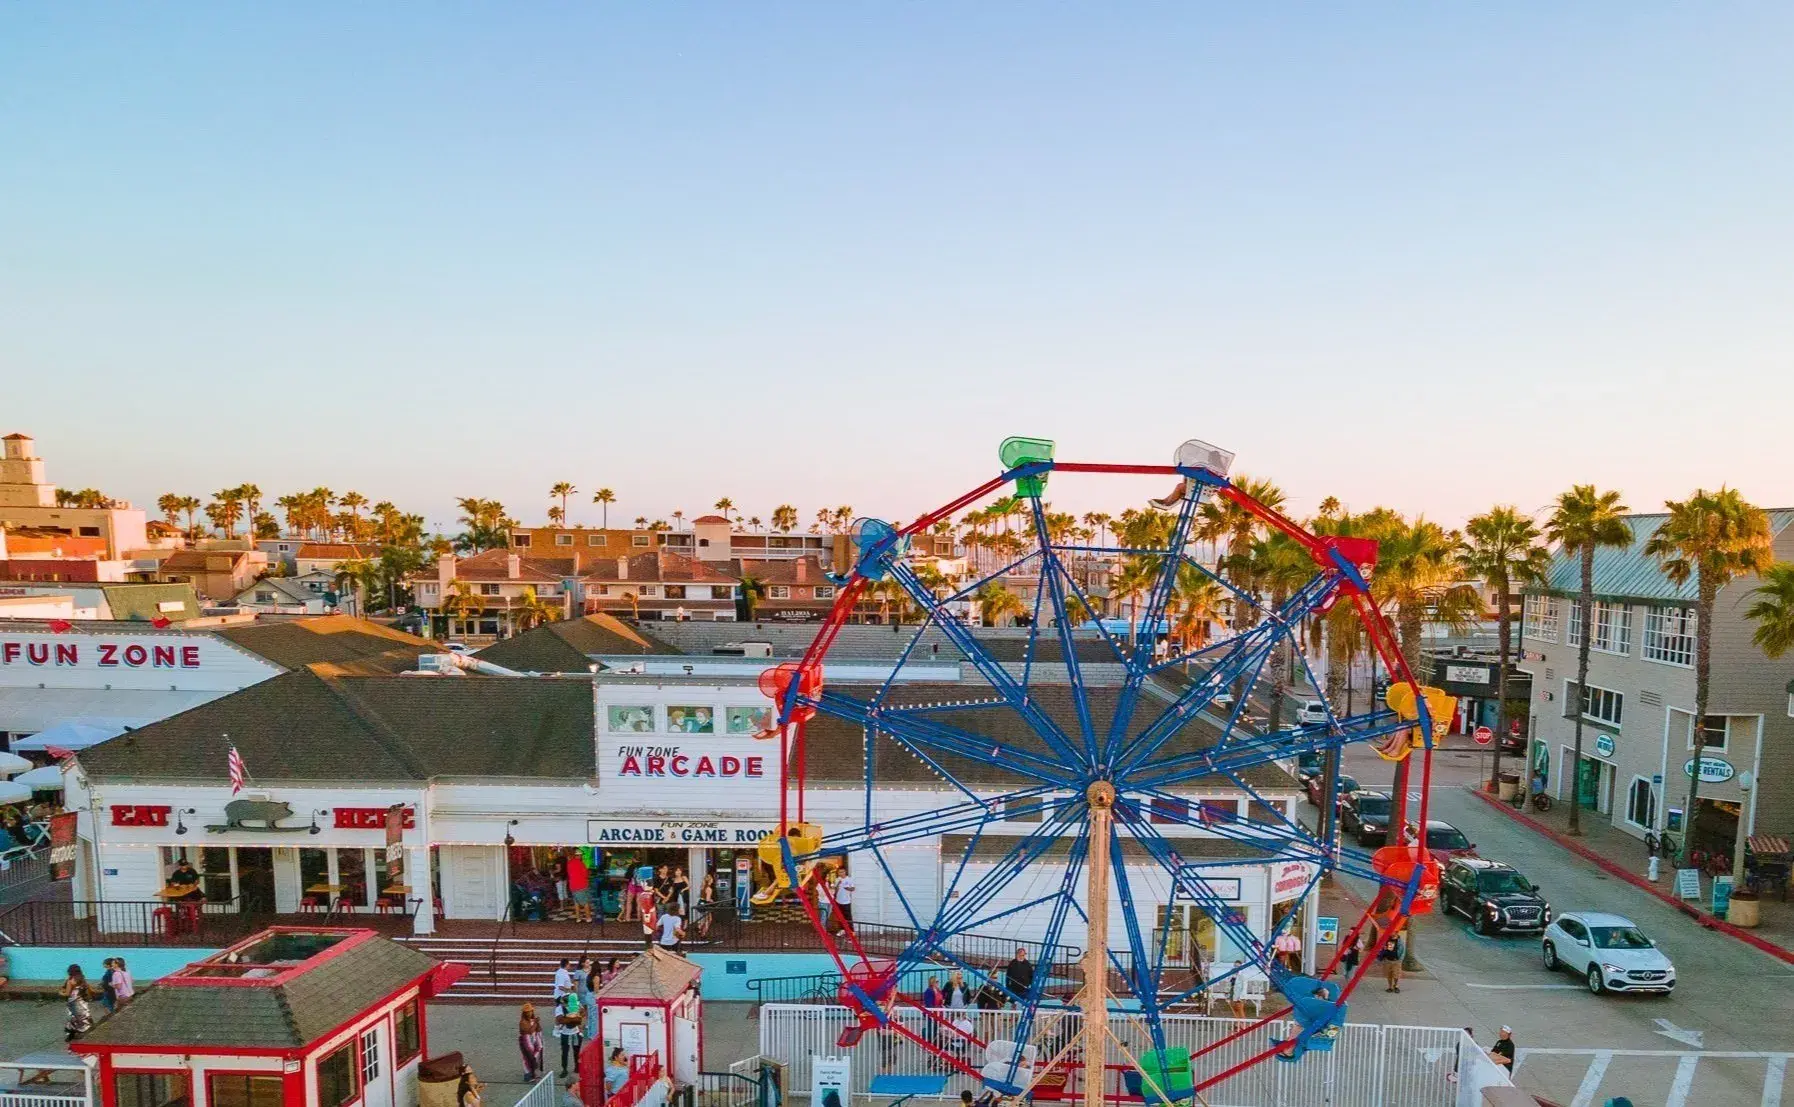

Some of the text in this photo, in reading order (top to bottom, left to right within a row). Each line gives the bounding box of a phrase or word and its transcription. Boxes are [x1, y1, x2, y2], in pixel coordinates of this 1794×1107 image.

[2, 643, 200, 669] FUN ZONE
[618, 746, 680, 758] FUN ZONE
[618, 756, 764, 778] ARCADE
[1703, 766, 1731, 777] RENTALS
[110, 805, 172, 826] EAT
[600, 828, 665, 841] ARCADE
[681, 829, 727, 842] GAME
[735, 830, 774, 842] ROO
